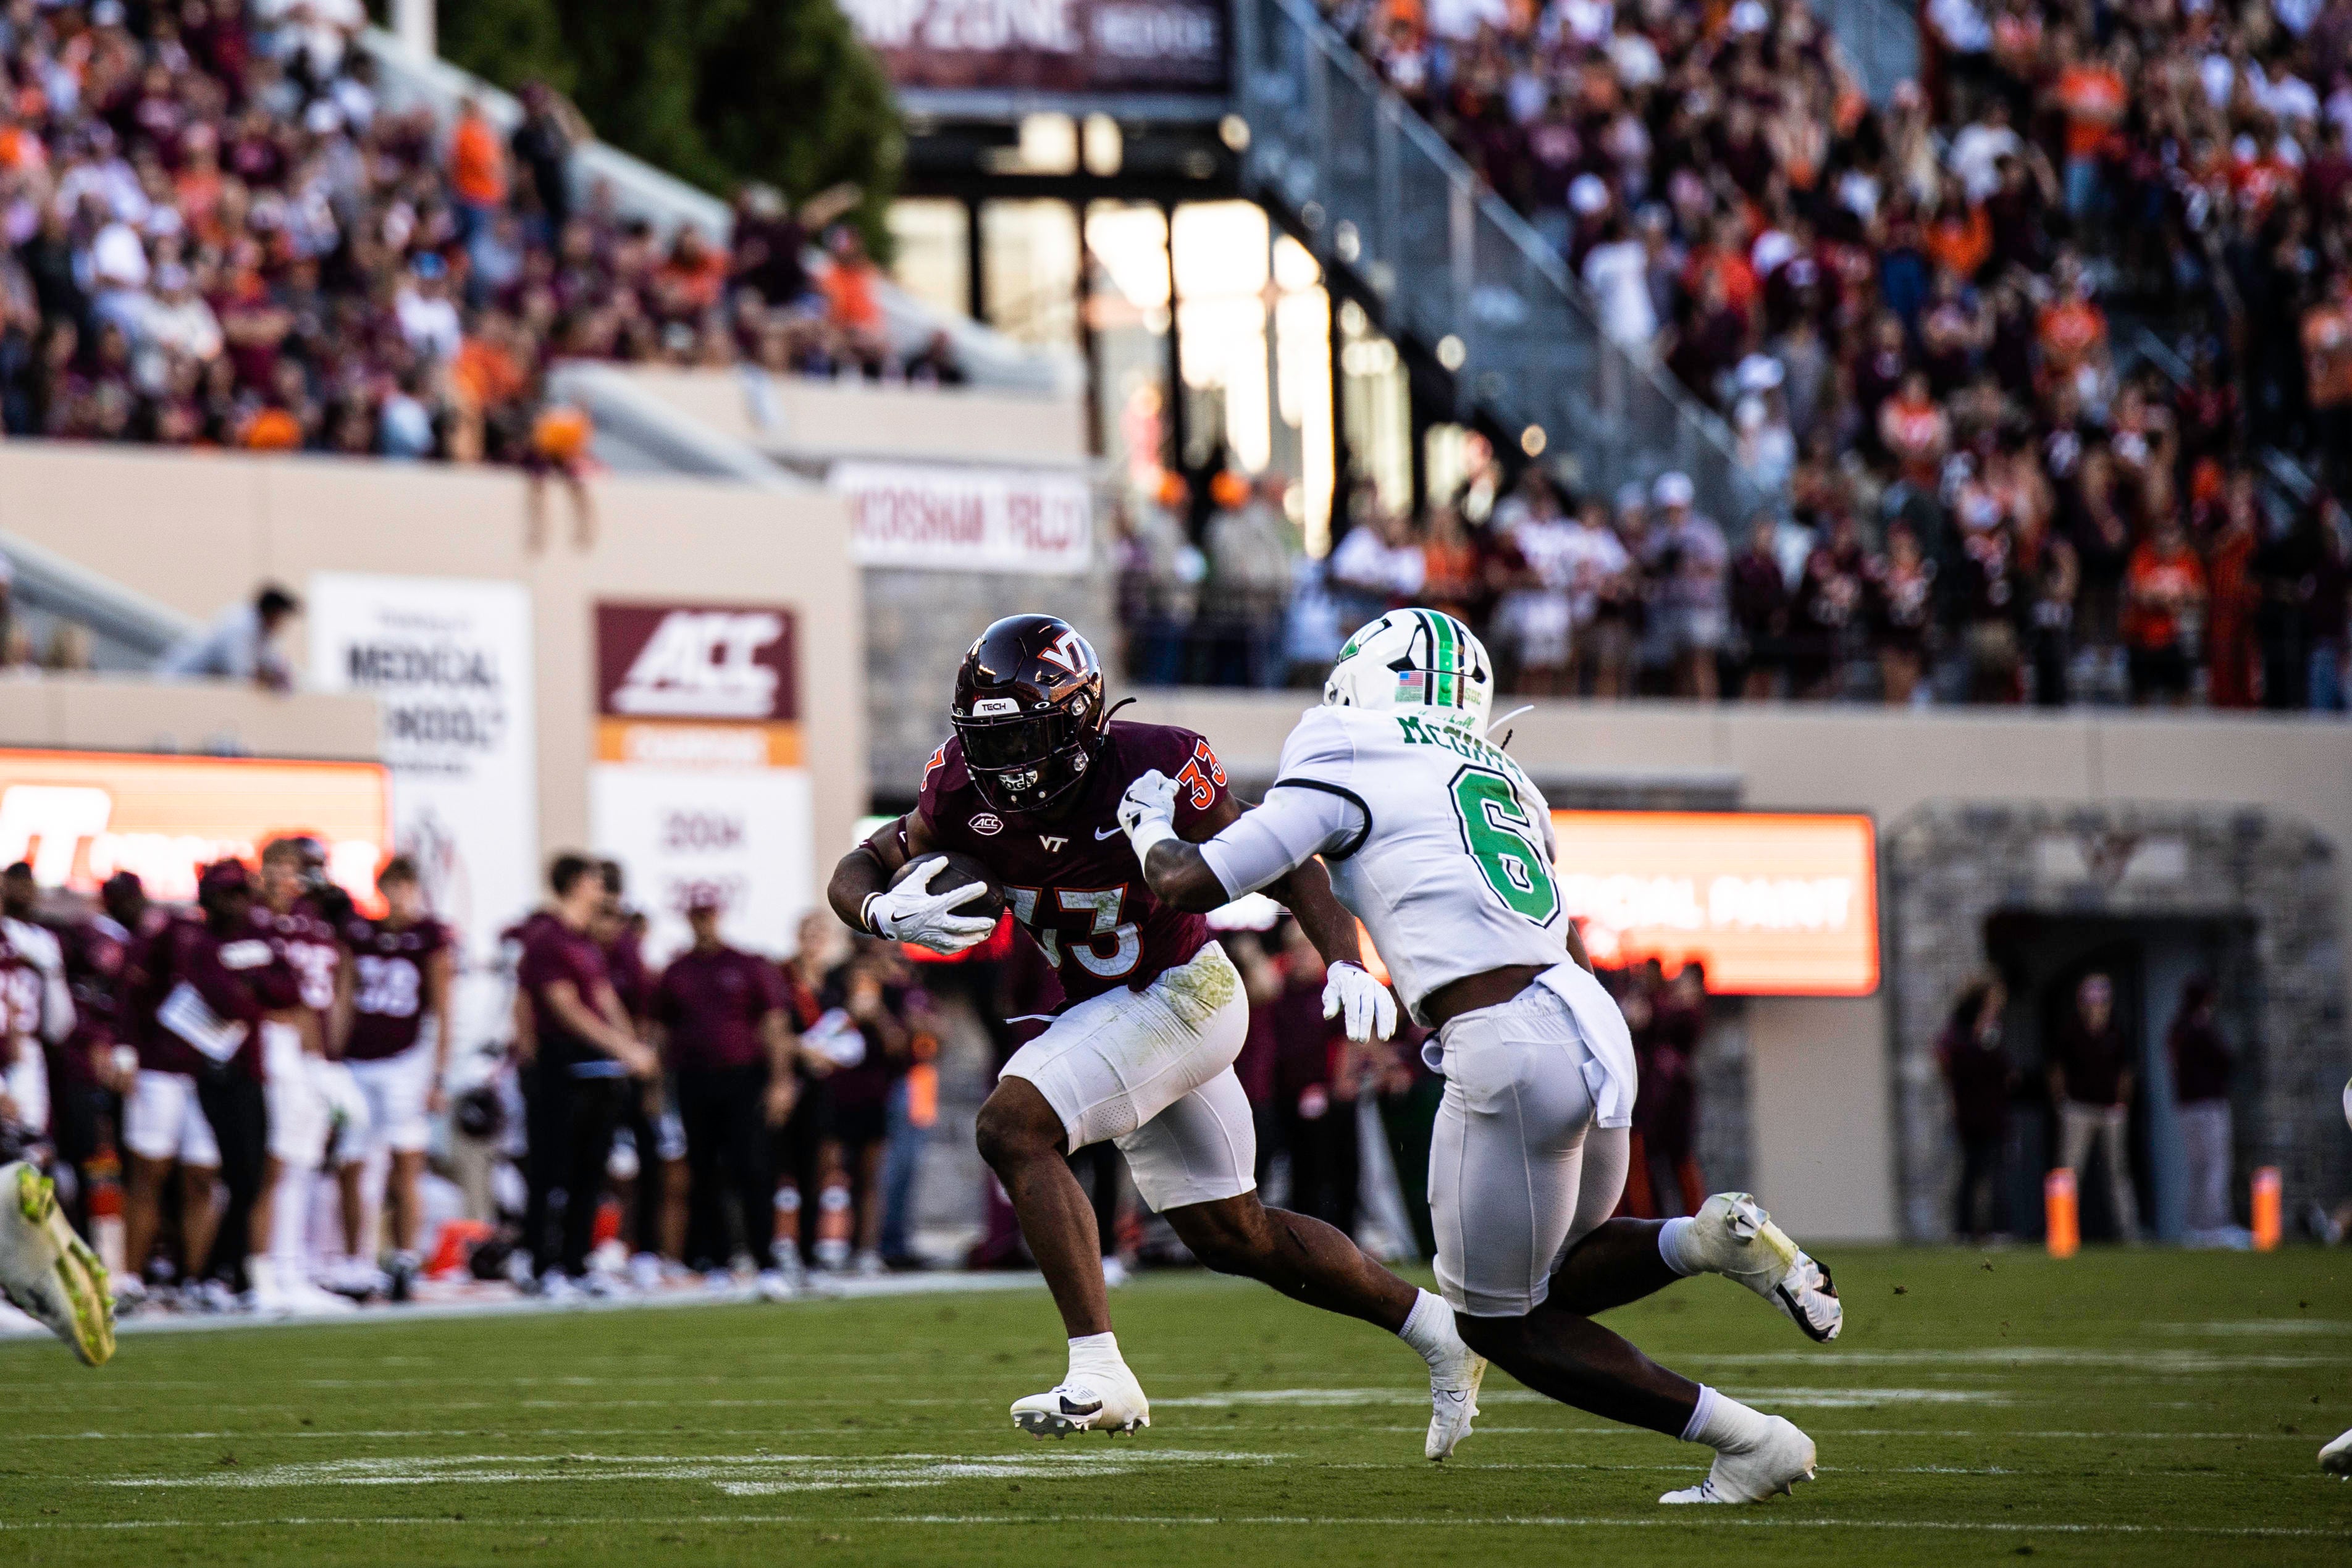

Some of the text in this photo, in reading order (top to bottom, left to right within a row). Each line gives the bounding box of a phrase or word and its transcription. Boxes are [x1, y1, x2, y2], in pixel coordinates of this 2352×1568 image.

[615, 610, 782, 704] ACC
[1036, 629, 1091, 678] VT
[981, 702, 1007, 711] TECH
[1175, 738, 1227, 810] 33
[1039, 835, 1069, 852] VT
[1447, 763, 1561, 929] 6
